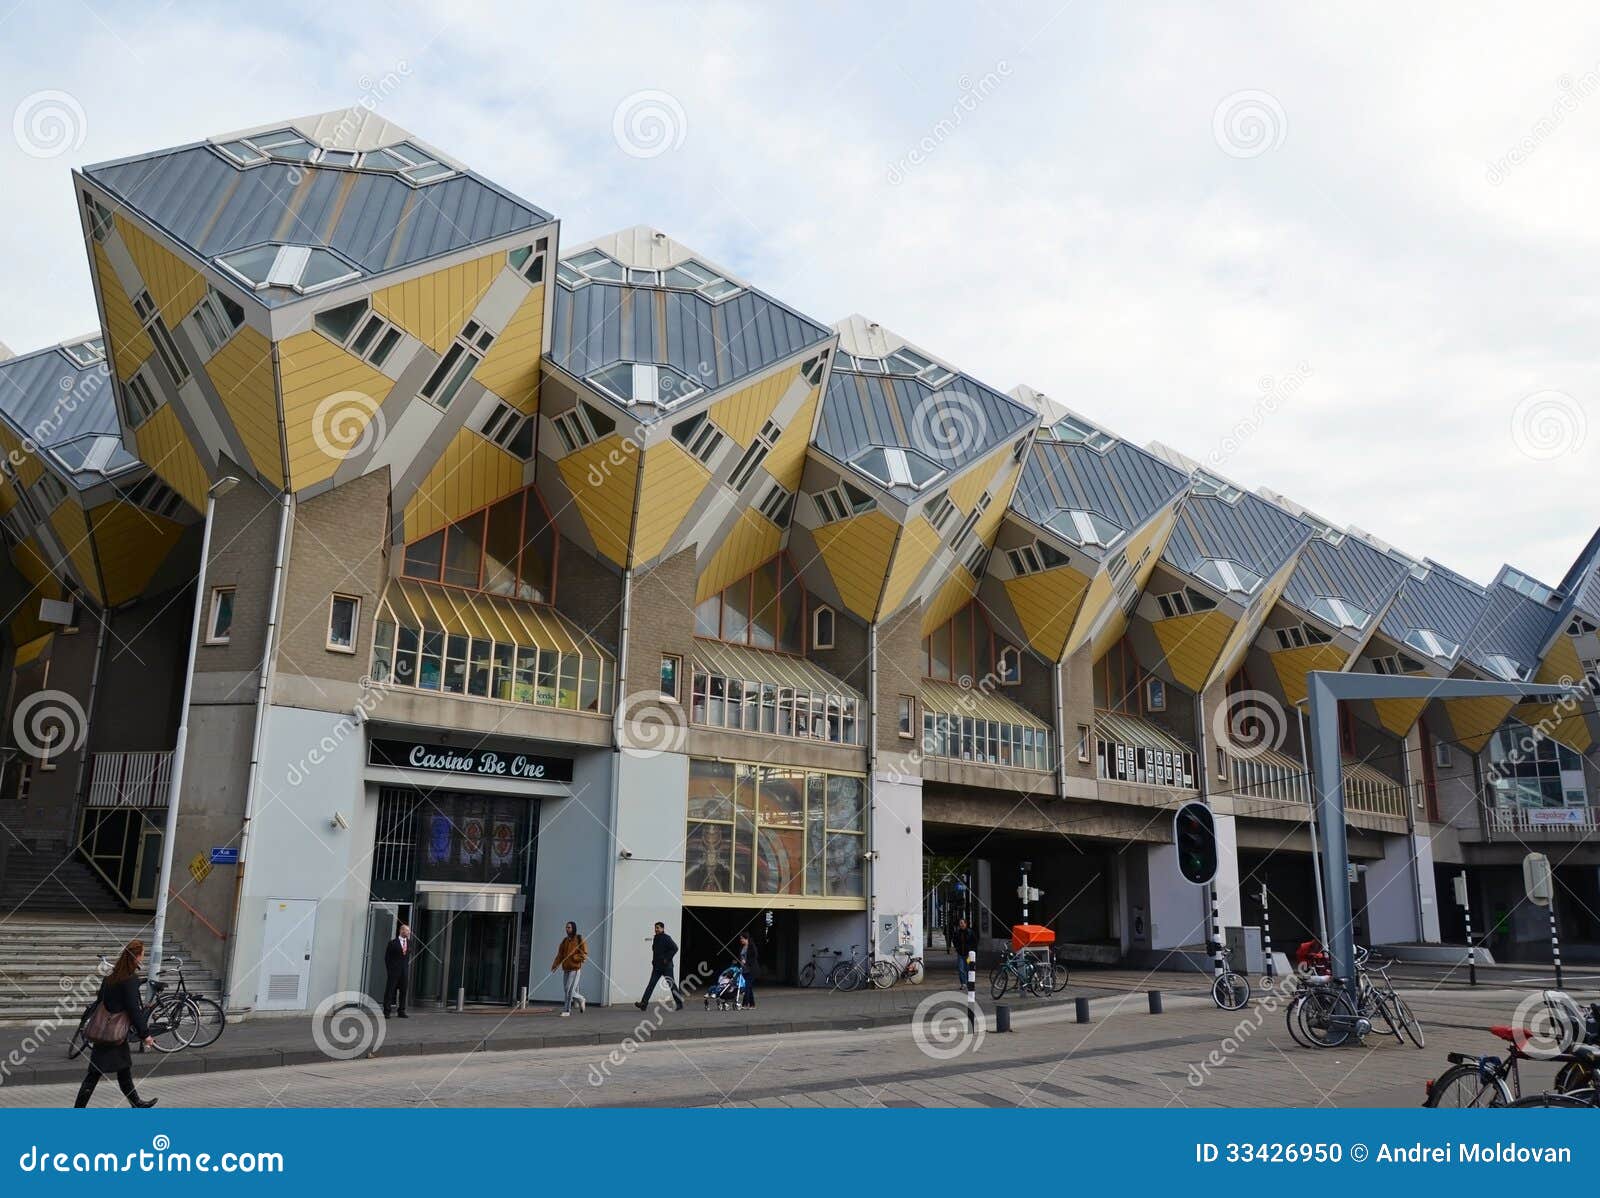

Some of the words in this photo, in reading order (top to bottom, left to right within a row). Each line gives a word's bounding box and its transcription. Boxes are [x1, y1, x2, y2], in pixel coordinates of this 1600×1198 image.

[409, 745, 473, 772] Casino
[478, 752, 506, 774] Be
[511, 755, 545, 778] One
[1118, 745, 1134, 761] TE
[1147, 750, 1181, 768] KOOP
[1119, 759, 1135, 774] TE
